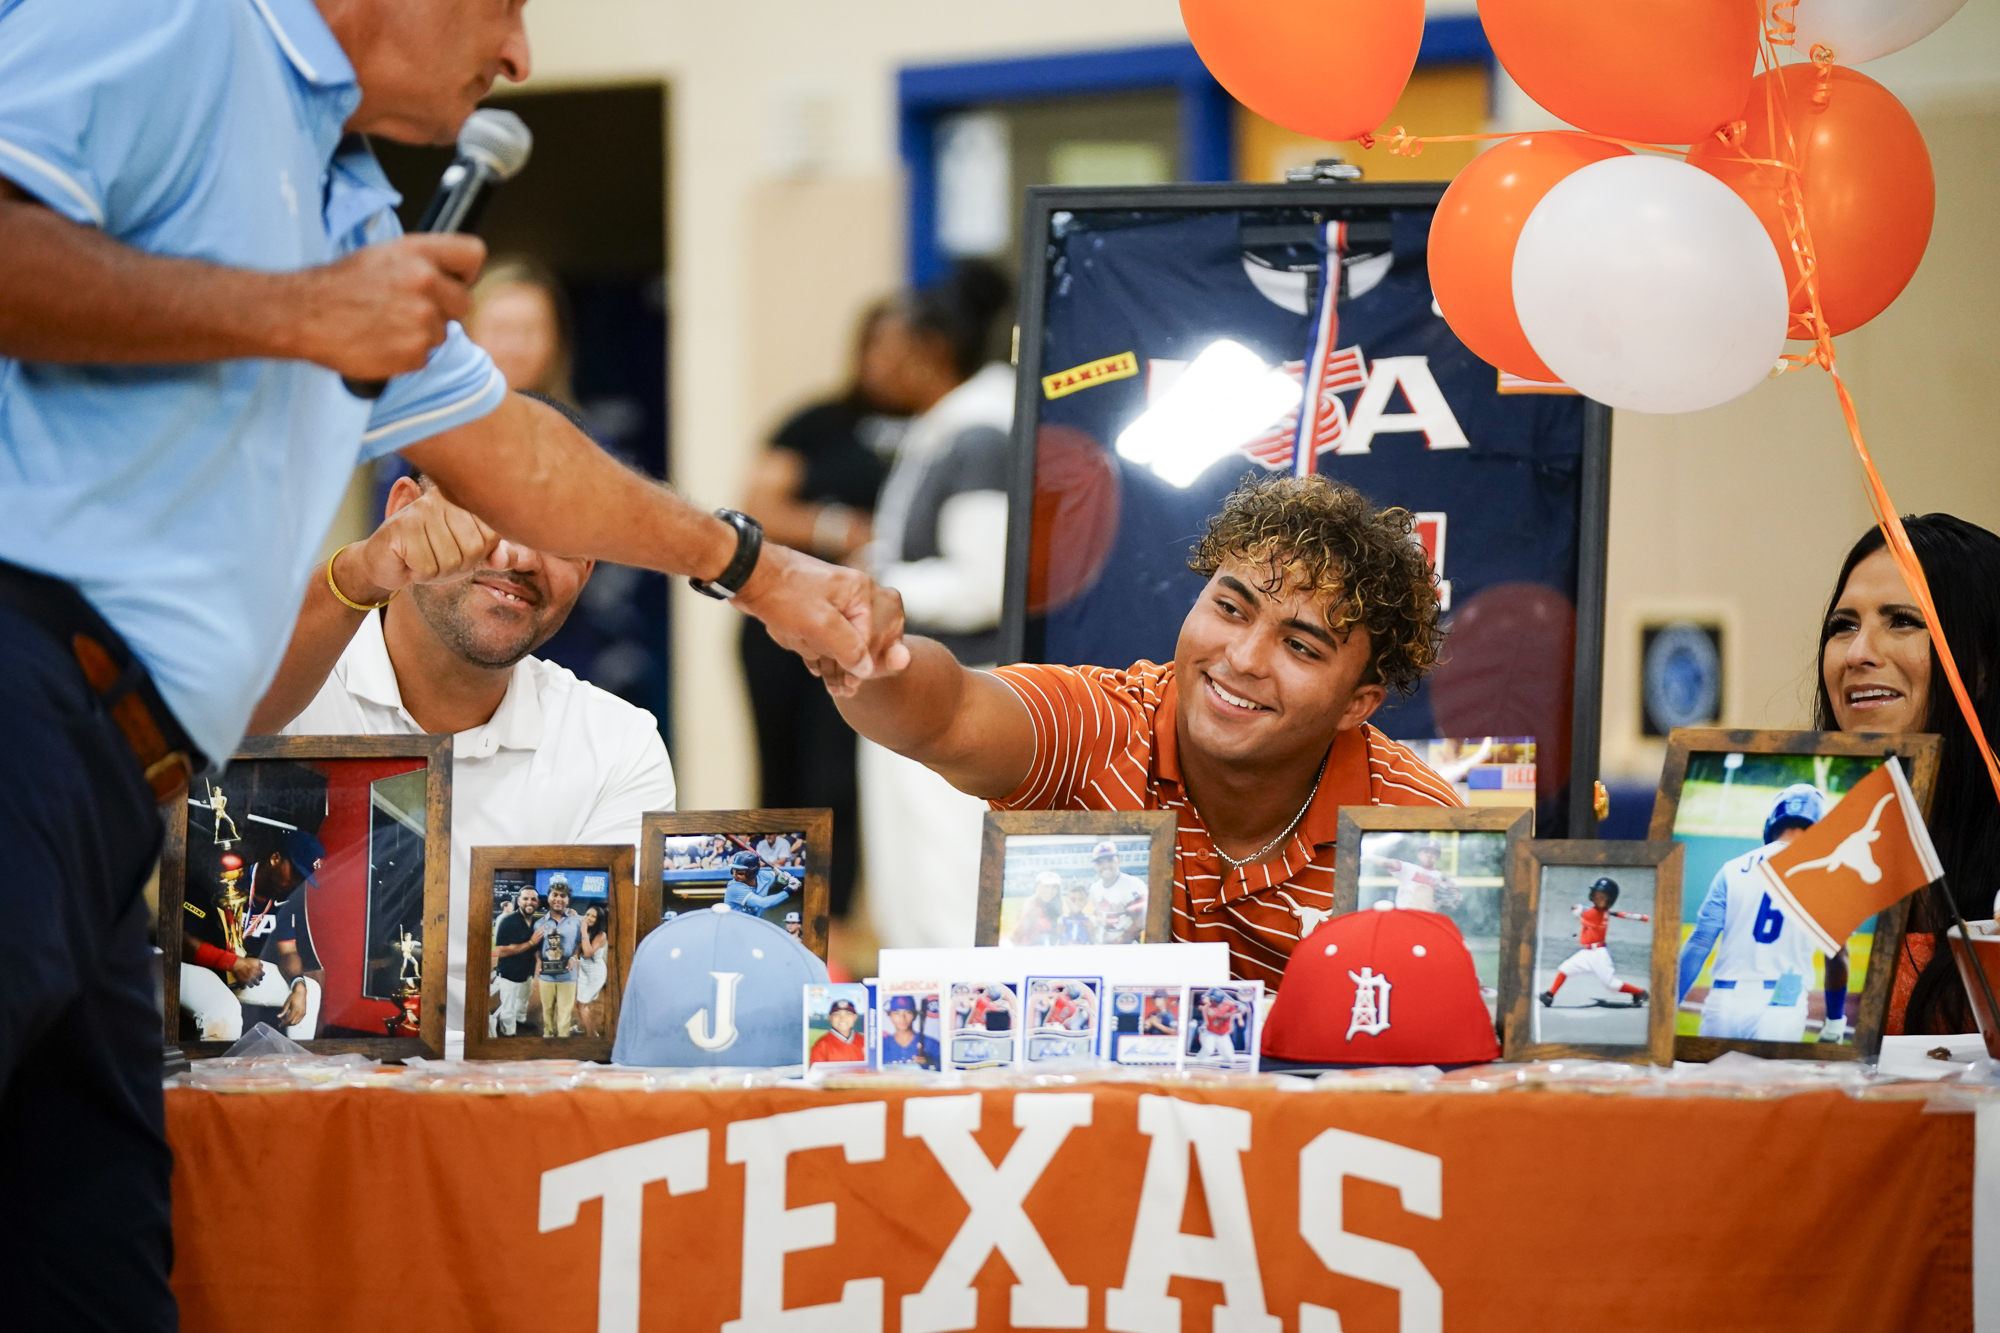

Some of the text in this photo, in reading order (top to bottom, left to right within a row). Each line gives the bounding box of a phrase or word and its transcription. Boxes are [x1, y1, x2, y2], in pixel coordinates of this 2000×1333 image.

[1051, 358, 1130, 391] PANINI
[1752, 890, 1785, 944] 6
[684, 970, 745, 1053] J
[538, 1092, 1443, 1333] TEXAS
